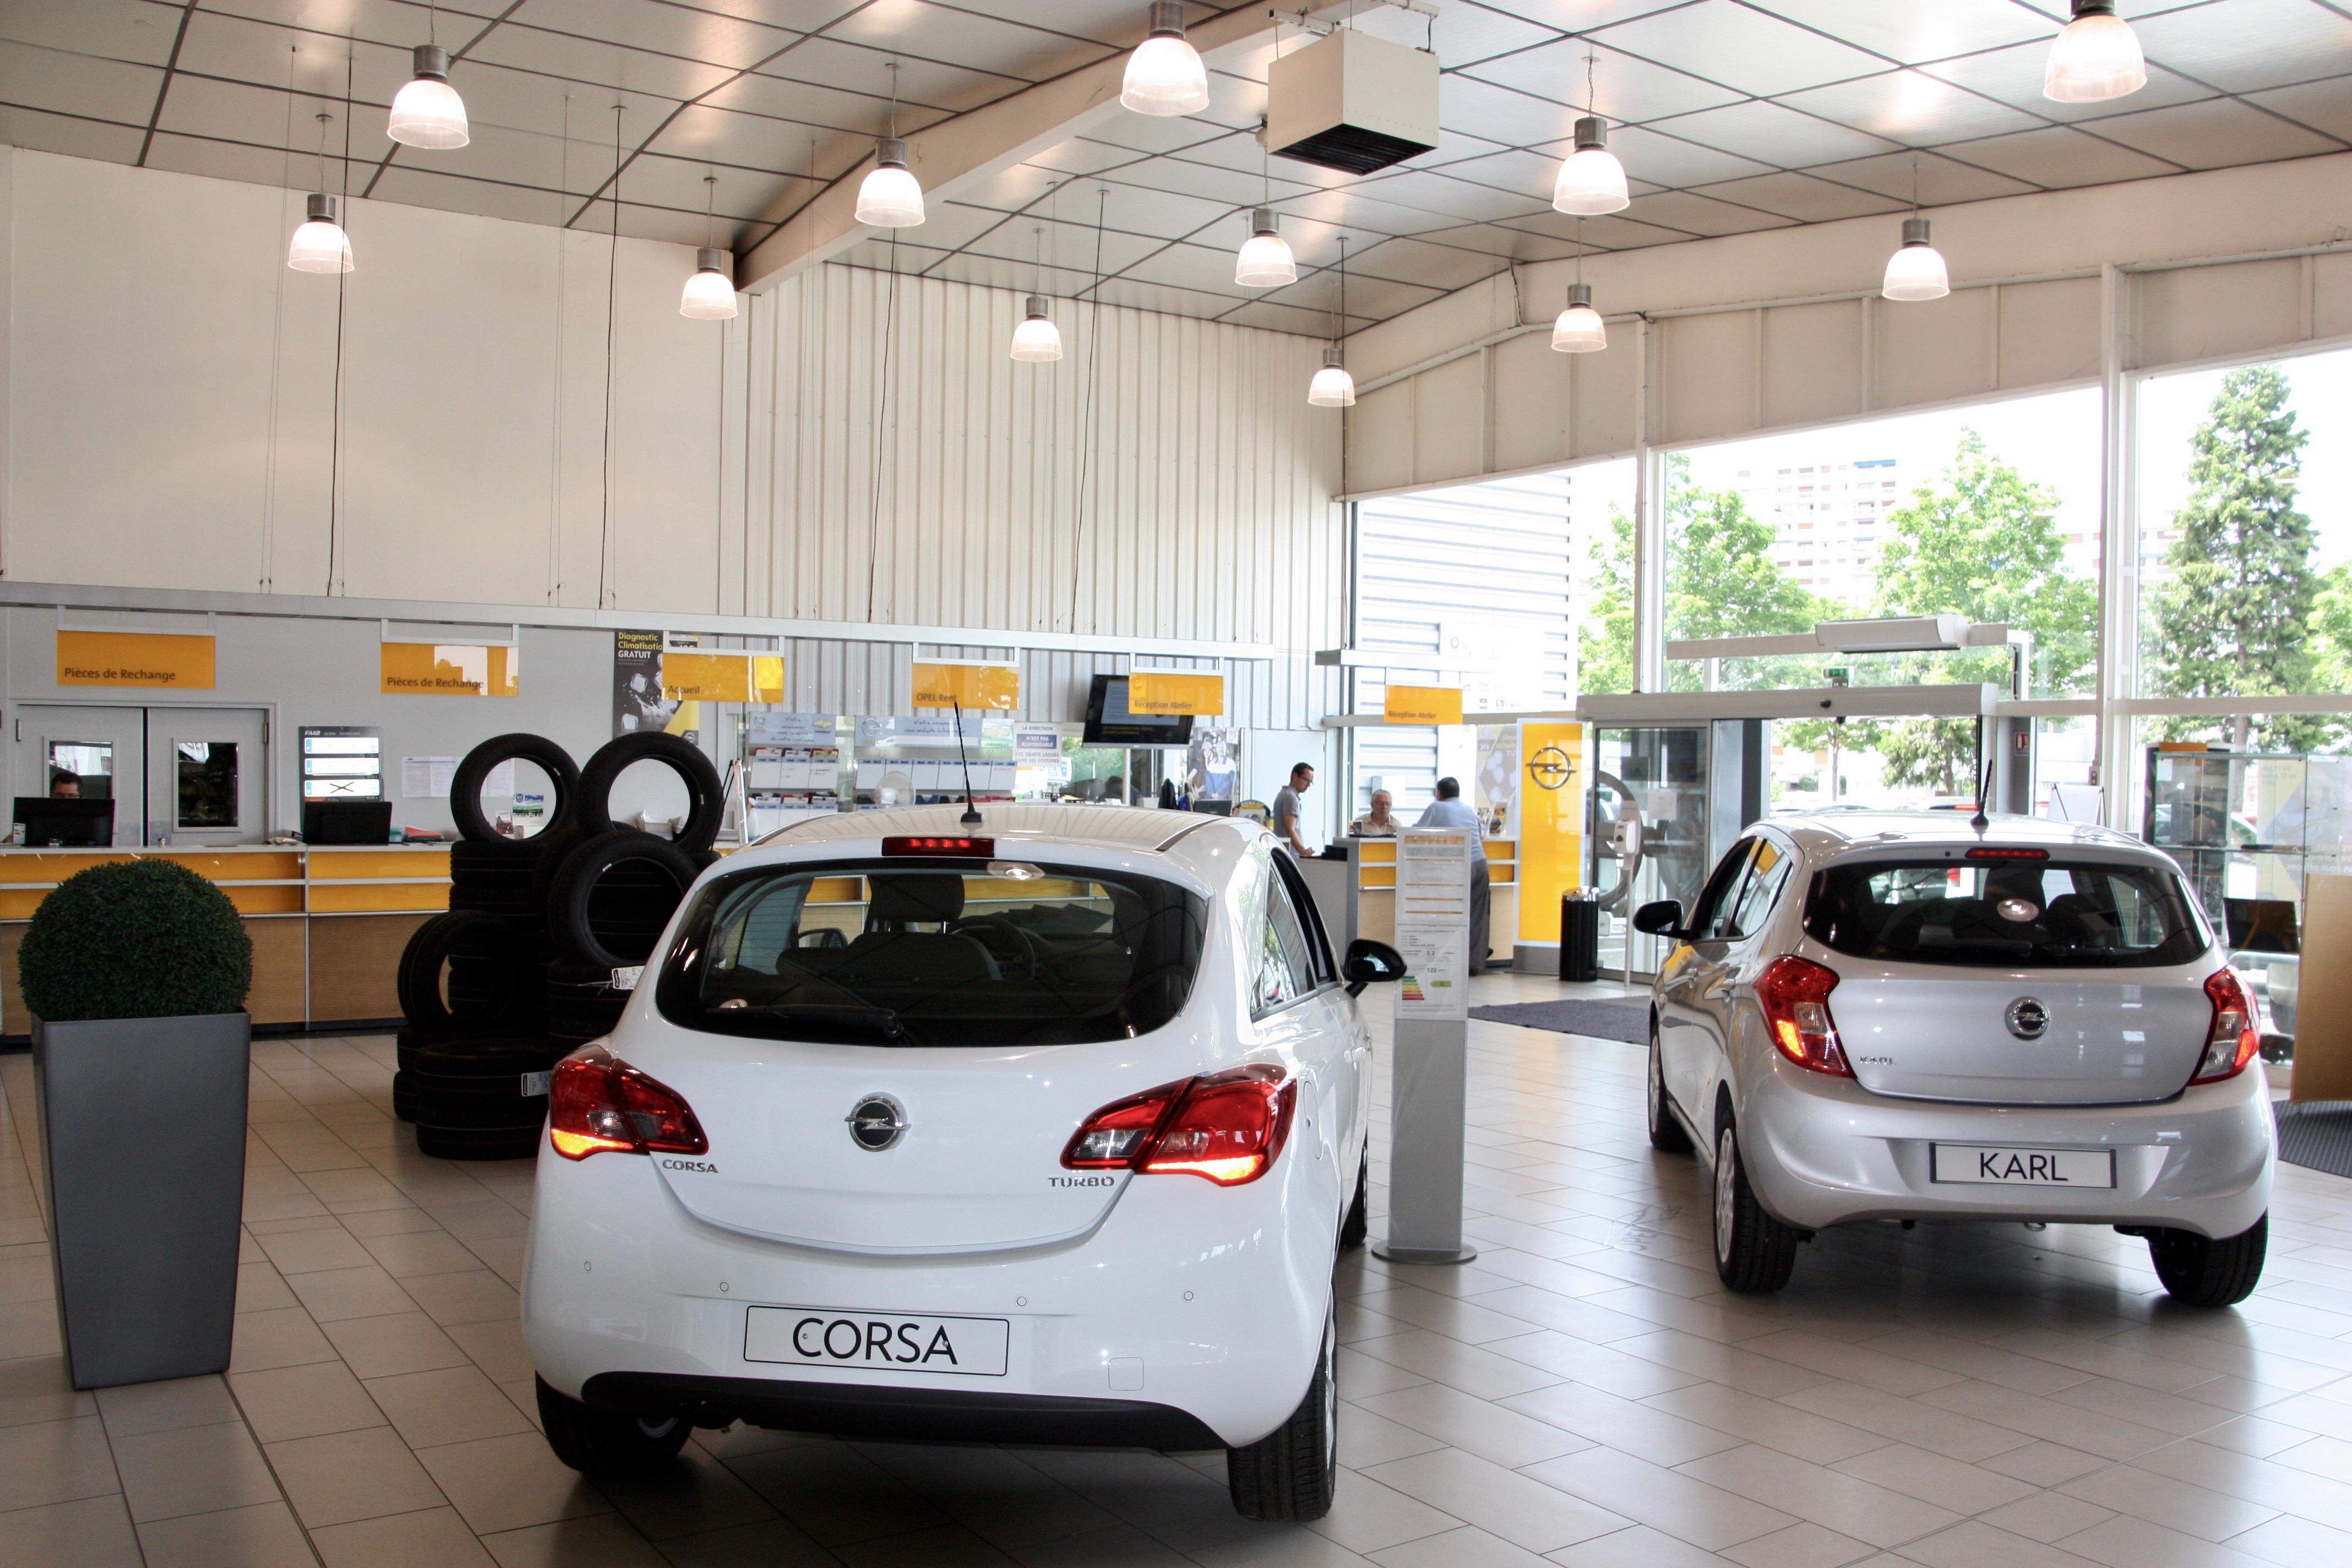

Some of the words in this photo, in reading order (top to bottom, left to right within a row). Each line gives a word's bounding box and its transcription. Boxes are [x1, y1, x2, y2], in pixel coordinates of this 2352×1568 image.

[618, 631, 658, 641] Diagnostic
[618, 641, 663, 650] Climatisatio
[618, 650, 651, 658] GRATUIT
[64, 667, 100, 678] Pièces
[103, 668, 117, 678] de
[121, 669, 176, 683] Rechange
[387, 677, 418, 686] Pièces
[421, 677, 433, 687] de
[436, 678, 484, 690] Rechange
[668, 685, 700, 694] Accueil
[916, 693, 937, 701] OPEL
[1134, 699, 1168, 709] Réception
[1387, 710, 1417, 719] Réception
[1860, 1056, 1897, 1065] KARL
[662, 1158, 719, 1174] CORSA
[1980, 1152, 2069, 1182] KARL
[1047, 1176, 1115, 1188] TURBO
[792, 1317, 959, 1365] CORSA
